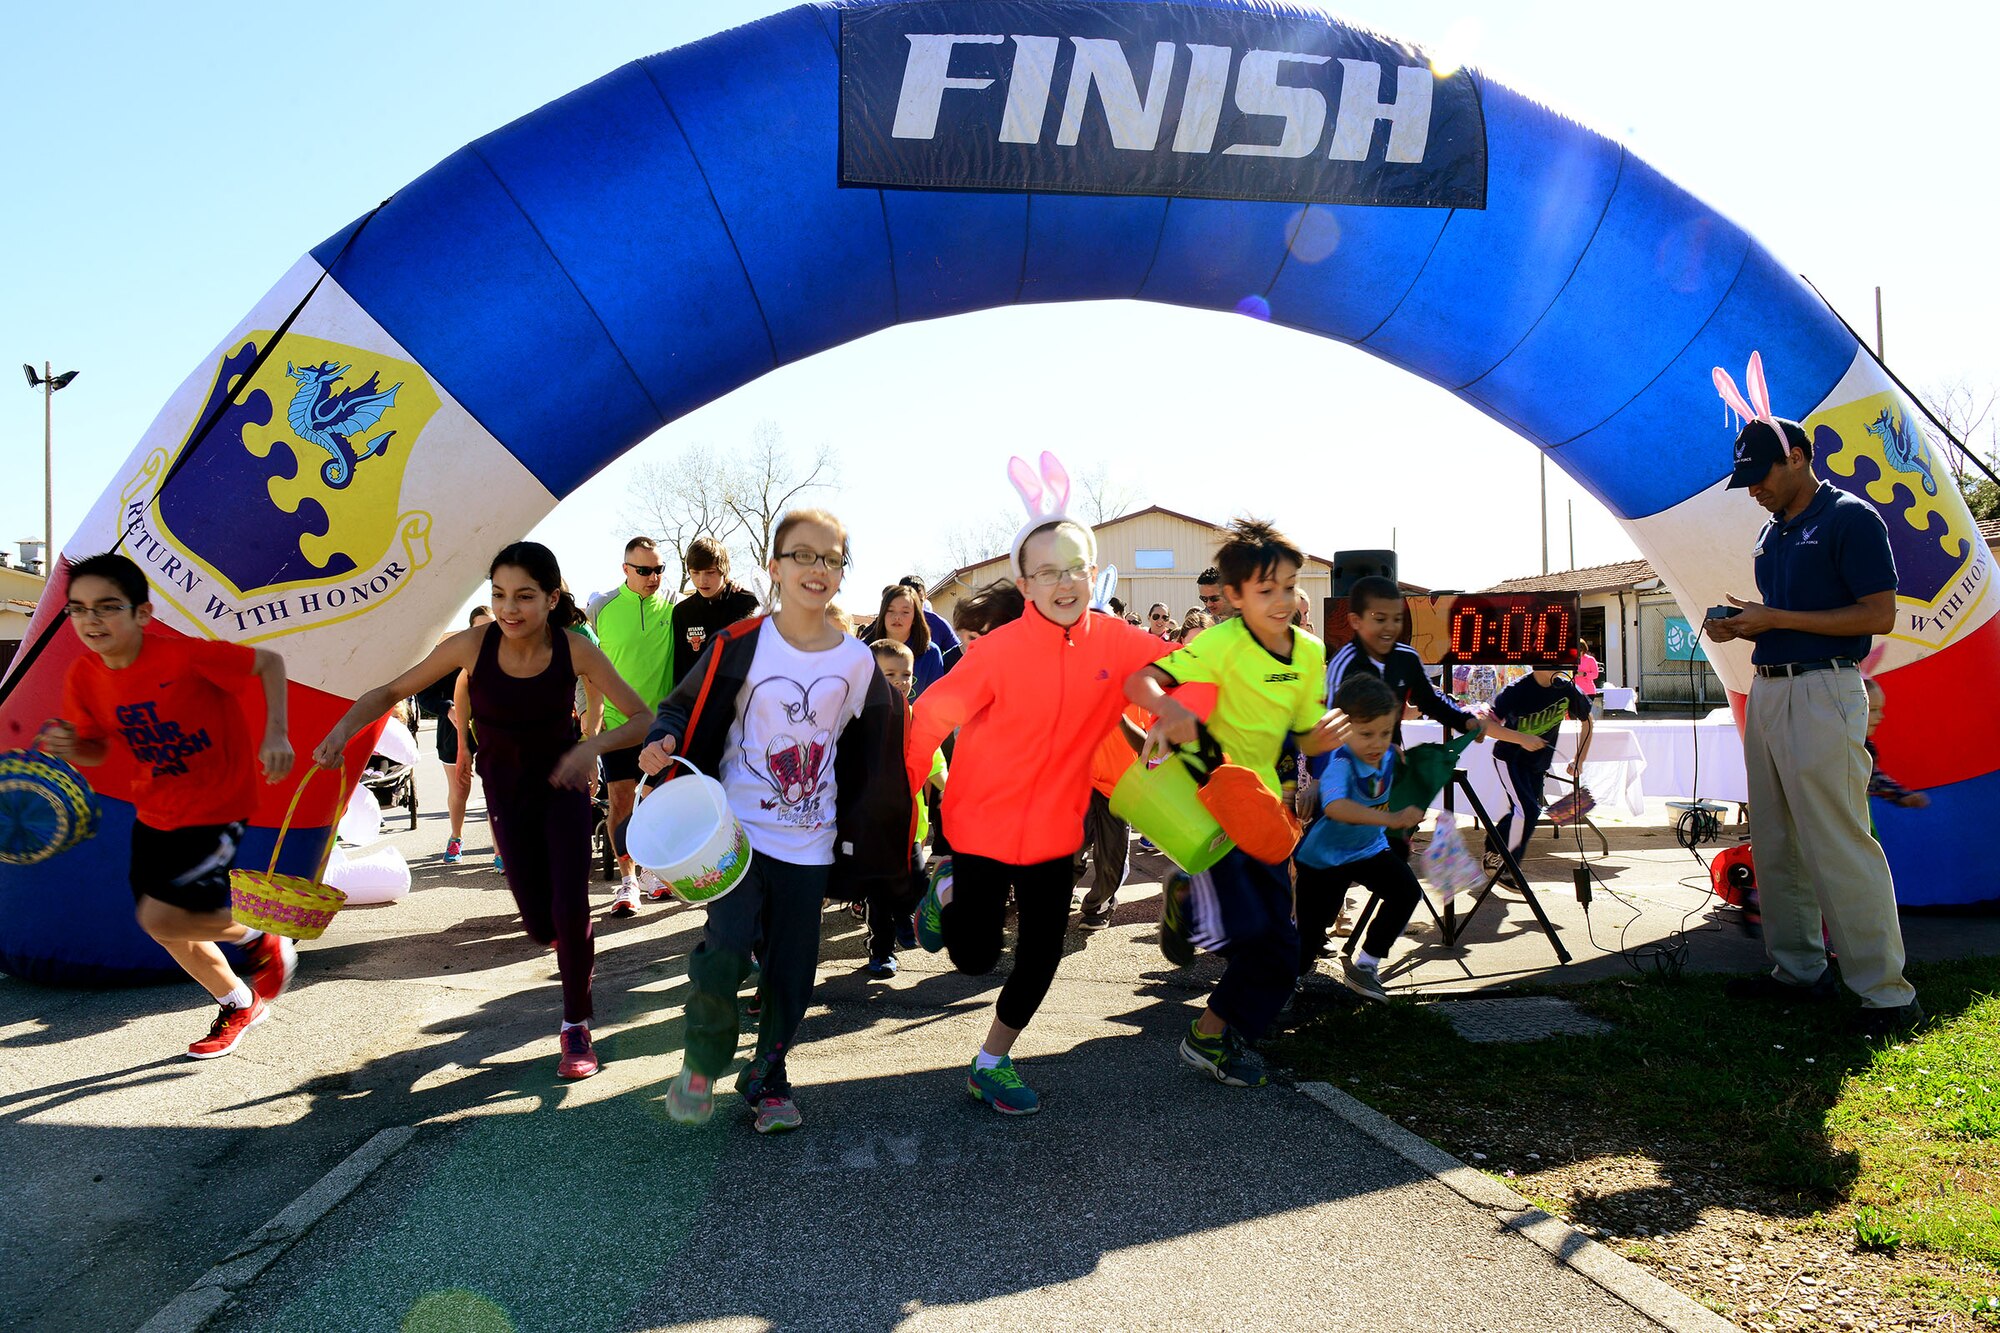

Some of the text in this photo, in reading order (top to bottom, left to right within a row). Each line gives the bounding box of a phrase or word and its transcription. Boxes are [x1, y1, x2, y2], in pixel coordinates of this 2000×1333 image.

[891, 34, 1433, 163] FINISH
[127, 500, 407, 631] RETURN WITH HONOR
[1452, 605, 1569, 659] 0:00
[1911, 592, 1965, 632] WITH
[116, 701, 159, 726] GET
[117, 721, 185, 747] YOUR
